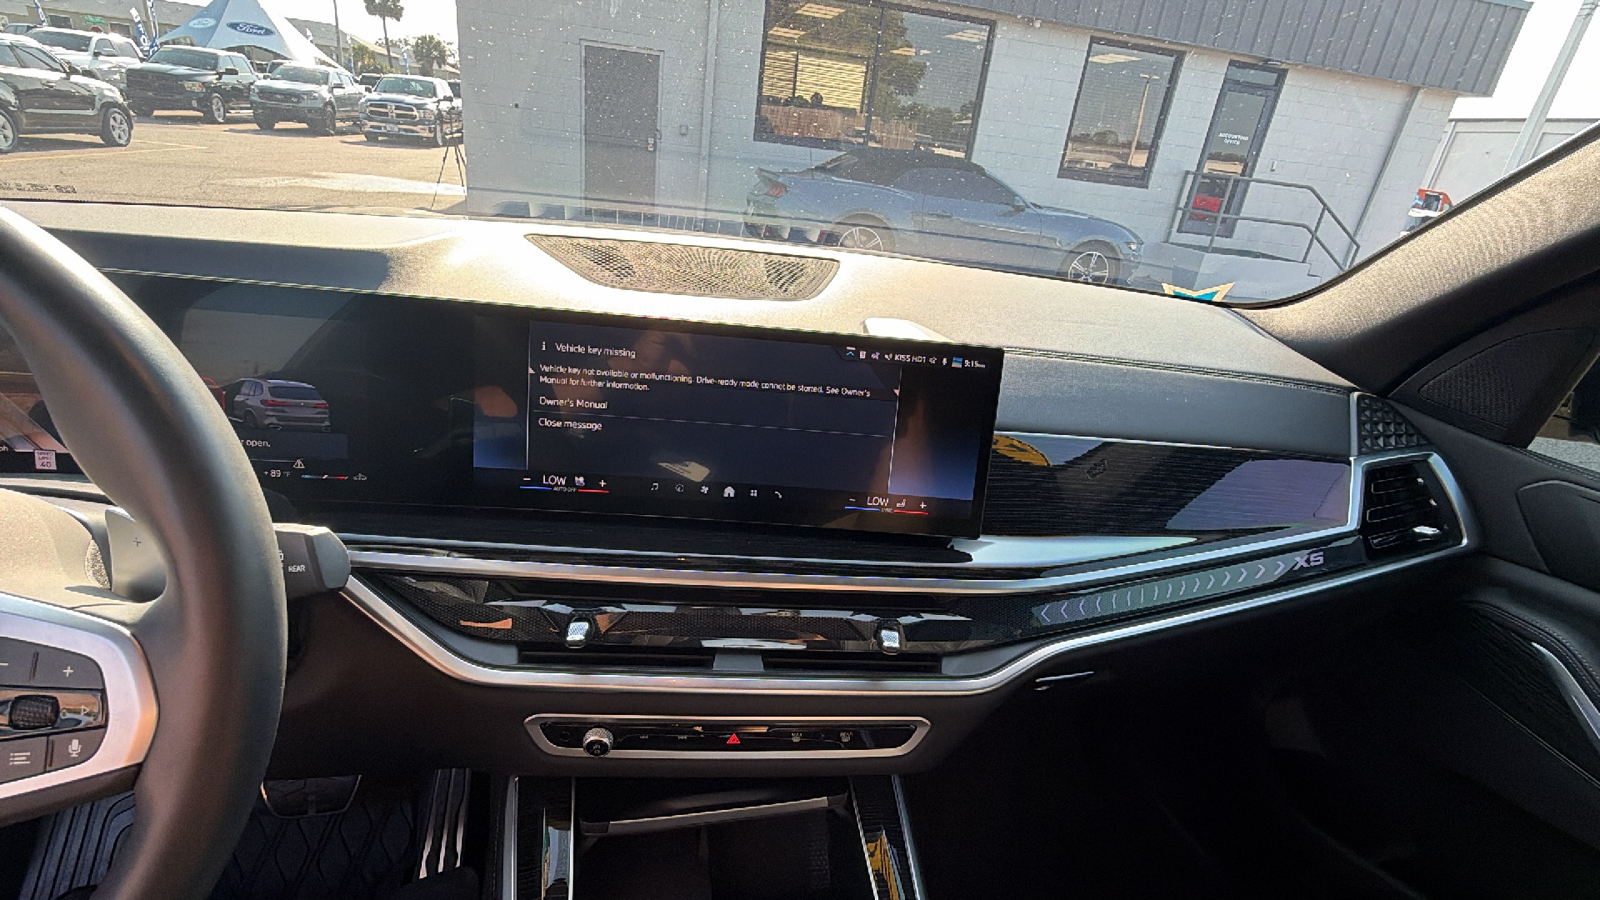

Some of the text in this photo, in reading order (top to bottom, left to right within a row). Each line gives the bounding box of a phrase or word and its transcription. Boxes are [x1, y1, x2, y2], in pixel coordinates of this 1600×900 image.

[237, 23, 266, 35] Ford
[555, 342, 636, 358] Vehicle key missing
[894, 354, 910, 362] KISS
[540, 363, 567, 373] Vehicle
[568, 366, 581, 376] key
[582, 368, 595, 376] not
[596, 368, 629, 378] available
[640, 371, 694, 384] malfunctioning.
[696, 376, 738, 387] Drive-ready
[739, 380, 760, 388] mode
[761, 382, 786, 390] cannot
[786, 382, 796, 391] be
[826, 386, 840, 394] See
[841, 386, 871, 398] Owner's
[540, 376, 650, 391] Manual for further information.
[540, 396, 608, 410] Owner's Manual
[538, 417, 602, 431] Close message
[246, 440, 270, 448] open.
[542, 474, 566, 486] LOW
[867, 496, 889, 506] LOW
[288, 564, 306, 572] REAR
